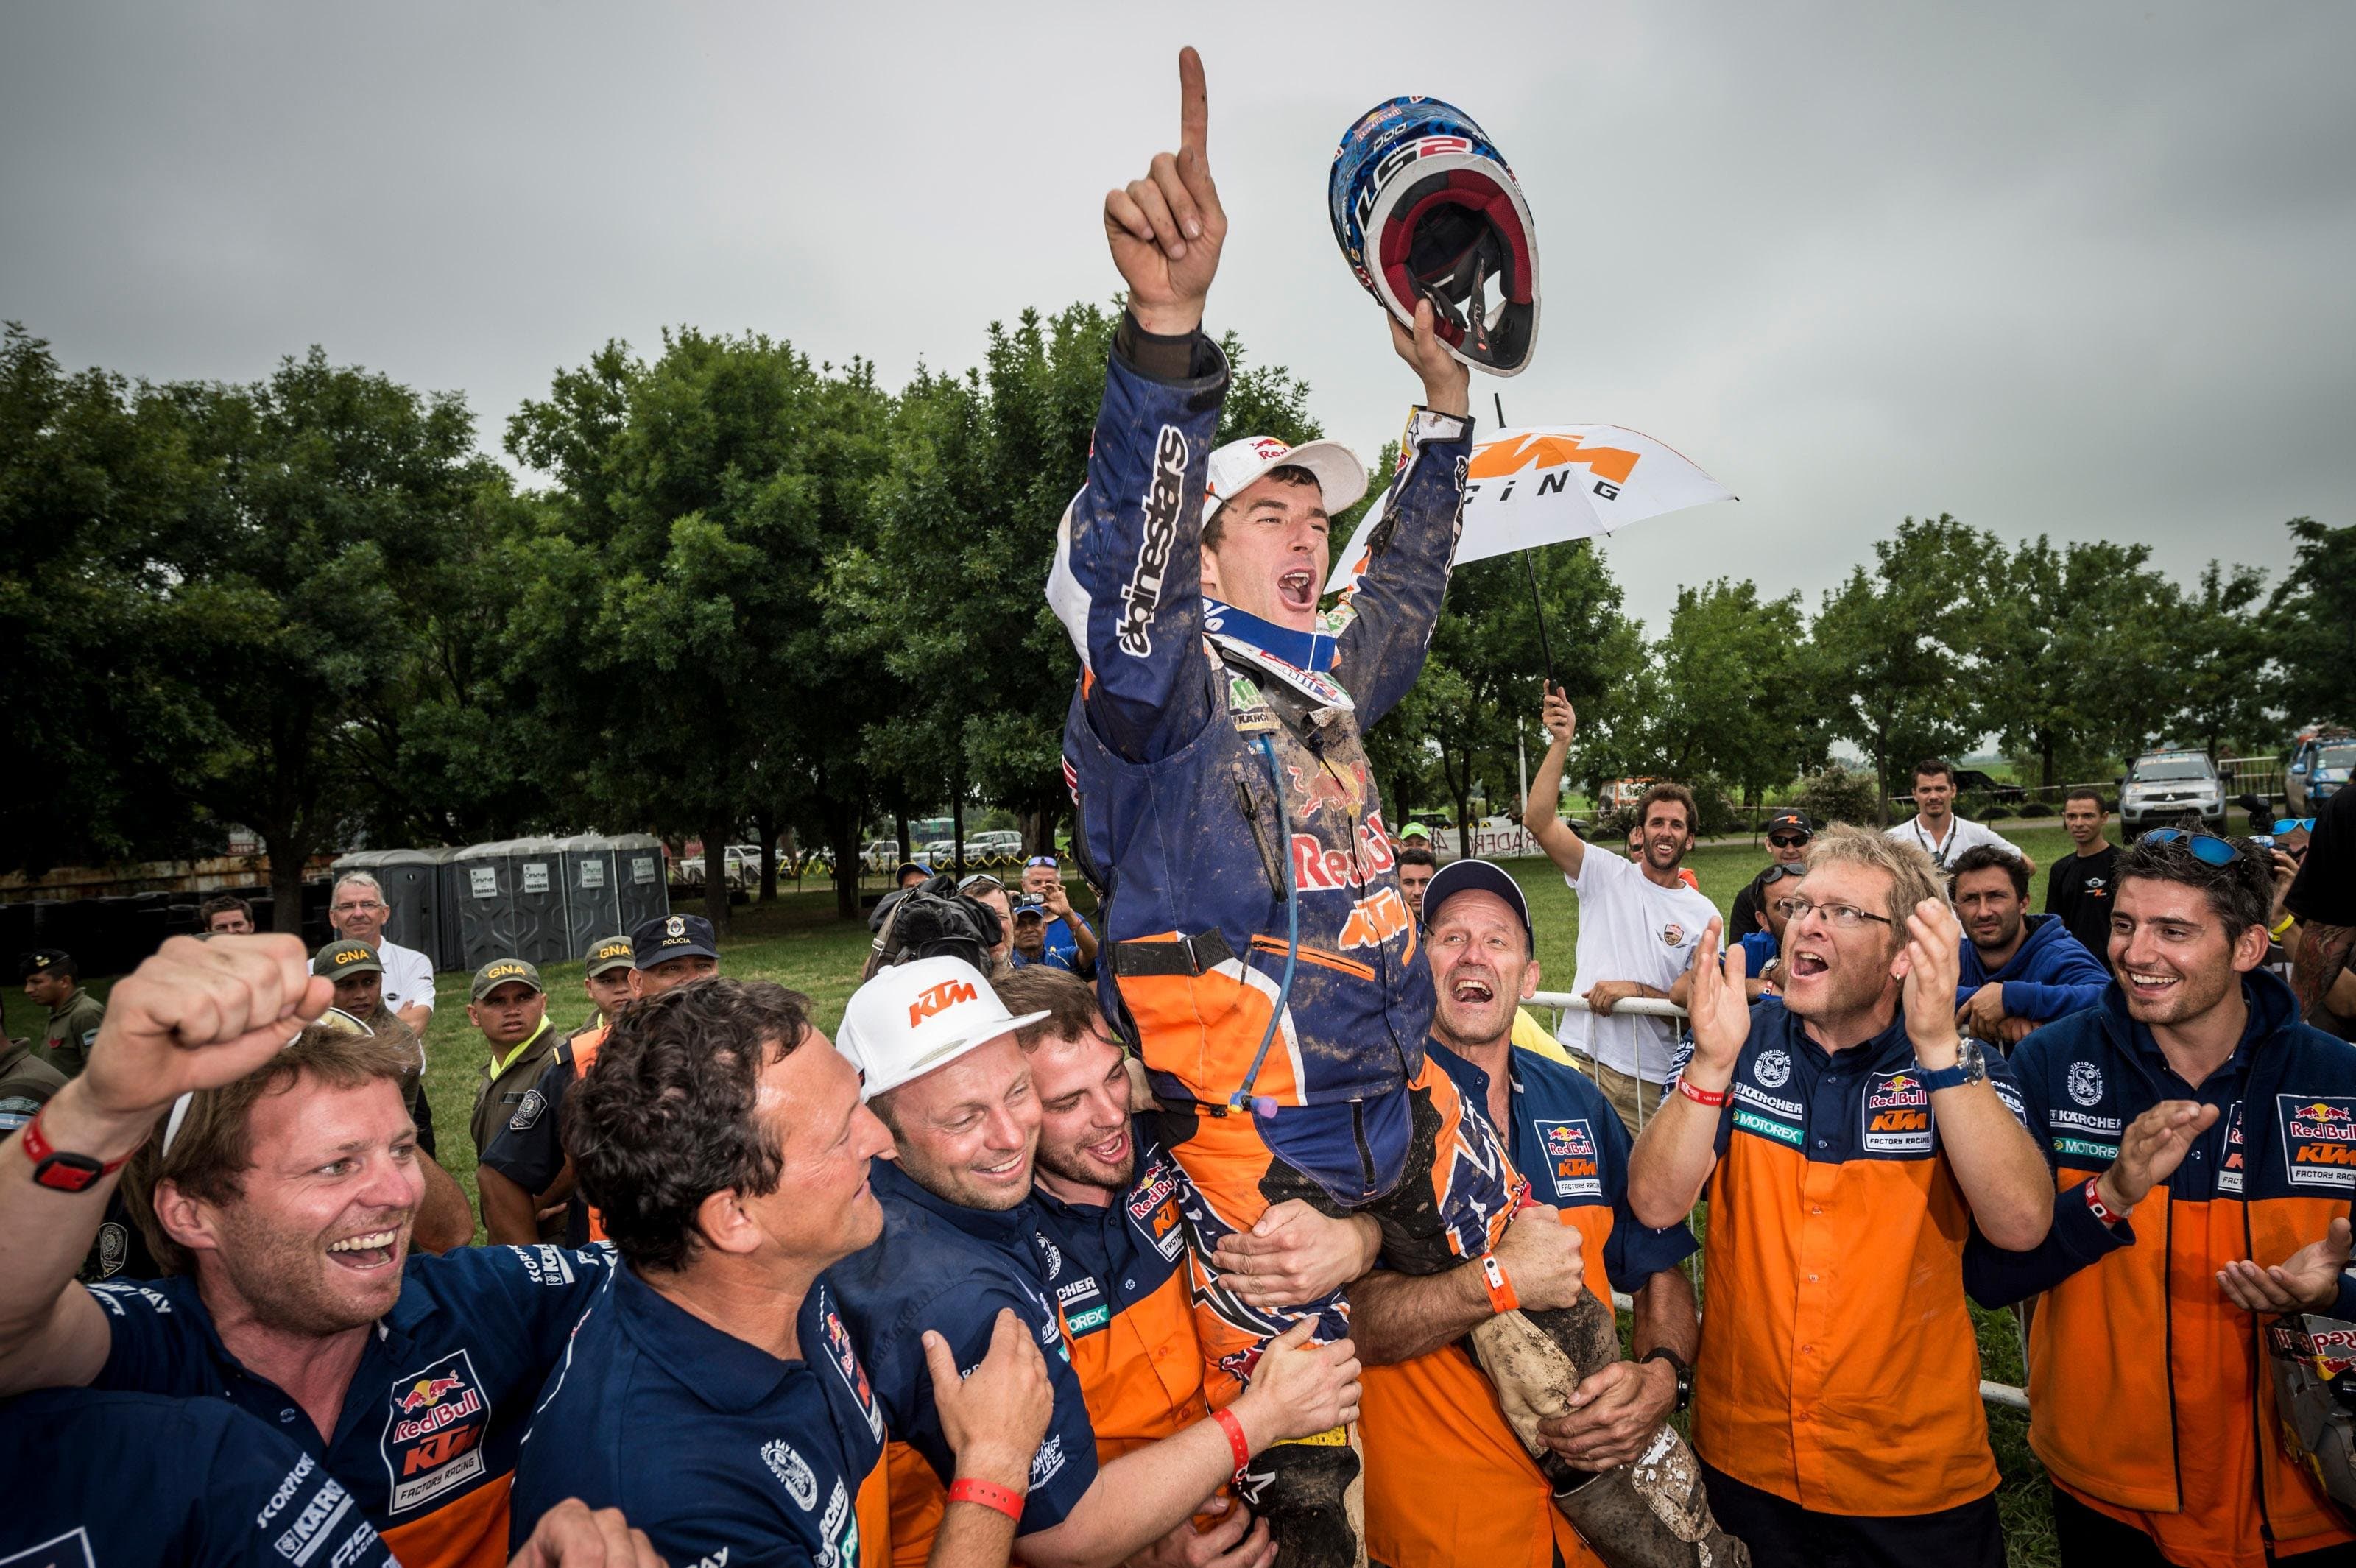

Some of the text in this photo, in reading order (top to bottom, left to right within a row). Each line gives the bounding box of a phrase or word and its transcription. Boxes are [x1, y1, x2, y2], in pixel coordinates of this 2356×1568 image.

[1116, 425, 1188, 657] alpinestars
[599, 944, 631, 958] GNA
[663, 937, 691, 946] POLICIA
[336, 949, 369, 965] GNA
[487, 964, 526, 978] GNA
[909, 980, 978, 1028] KTM
[1740, 1084, 1803, 1113] KÄRCHER
[1869, 1090, 1927, 1109] Red Bull
[1740, 1113, 1798, 1142] MOTOREX
[1870, 1109, 1927, 1131] KTM
[2290, 1122, 2324, 1138] Red
[1548, 1141, 1594, 1155] Red Bull
[2296, 1143, 2356, 1166] KTM
[1559, 1159, 1597, 1177] KTM
[2296, 1170, 2334, 1179] FACTORY
[2223, 1176, 2243, 1186] FACT
[1129, 1179, 1175, 1220] Red Bu
[1152, 1195, 1180, 1239] KT
[1165, 1229, 1183, 1251] FACTO
[1056, 1276, 1096, 1300] CHER
[1067, 1308, 1106, 1332] OREX
[392, 1388, 482, 1444] Red Bull
[403, 1424, 481, 1476] KTM
[401, 1474, 442, 1501] FACTORY
[687, 1547, 728, 1568] AY
